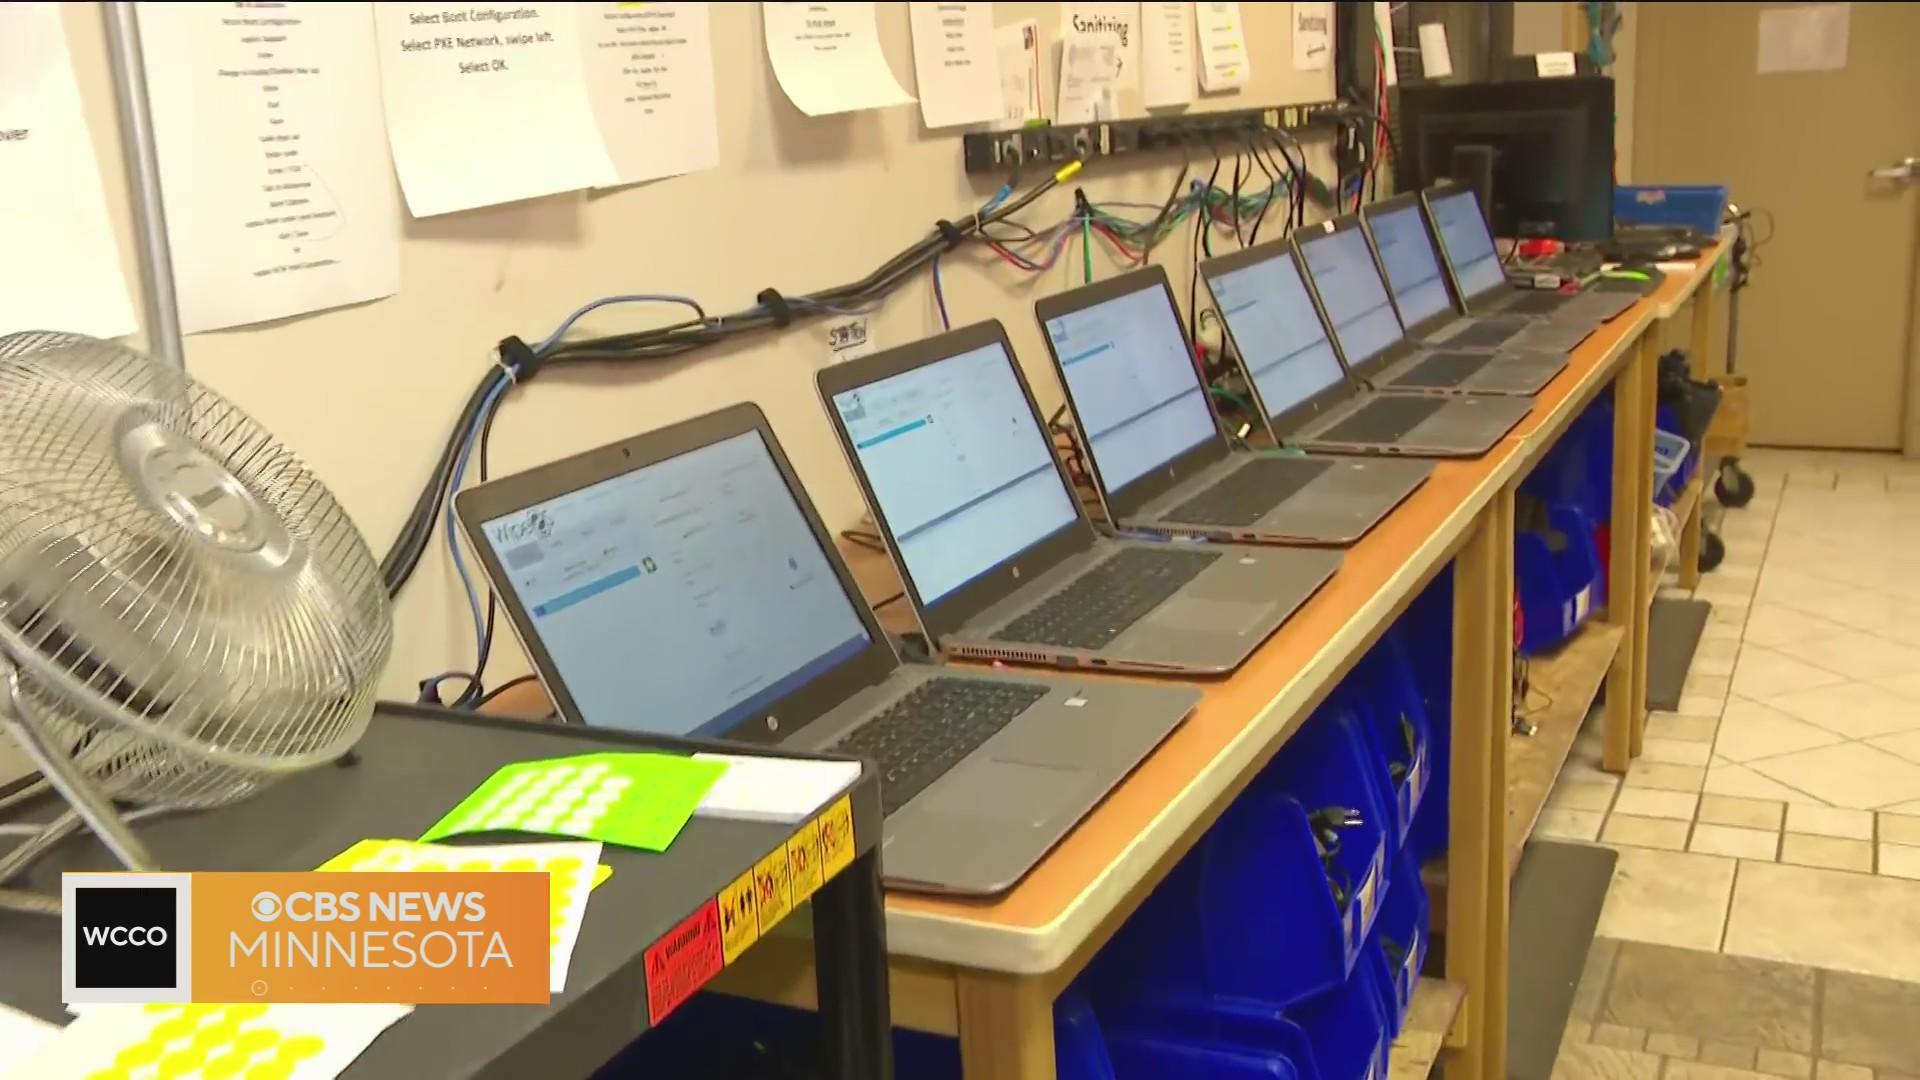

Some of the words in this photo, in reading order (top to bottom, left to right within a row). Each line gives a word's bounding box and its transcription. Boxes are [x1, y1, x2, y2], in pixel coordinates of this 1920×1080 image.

[409, 12, 441, 25] Select
[442, 11, 467, 24] Boot
[401, 39, 433, 52] Select
[458, 61, 490, 74] Select
